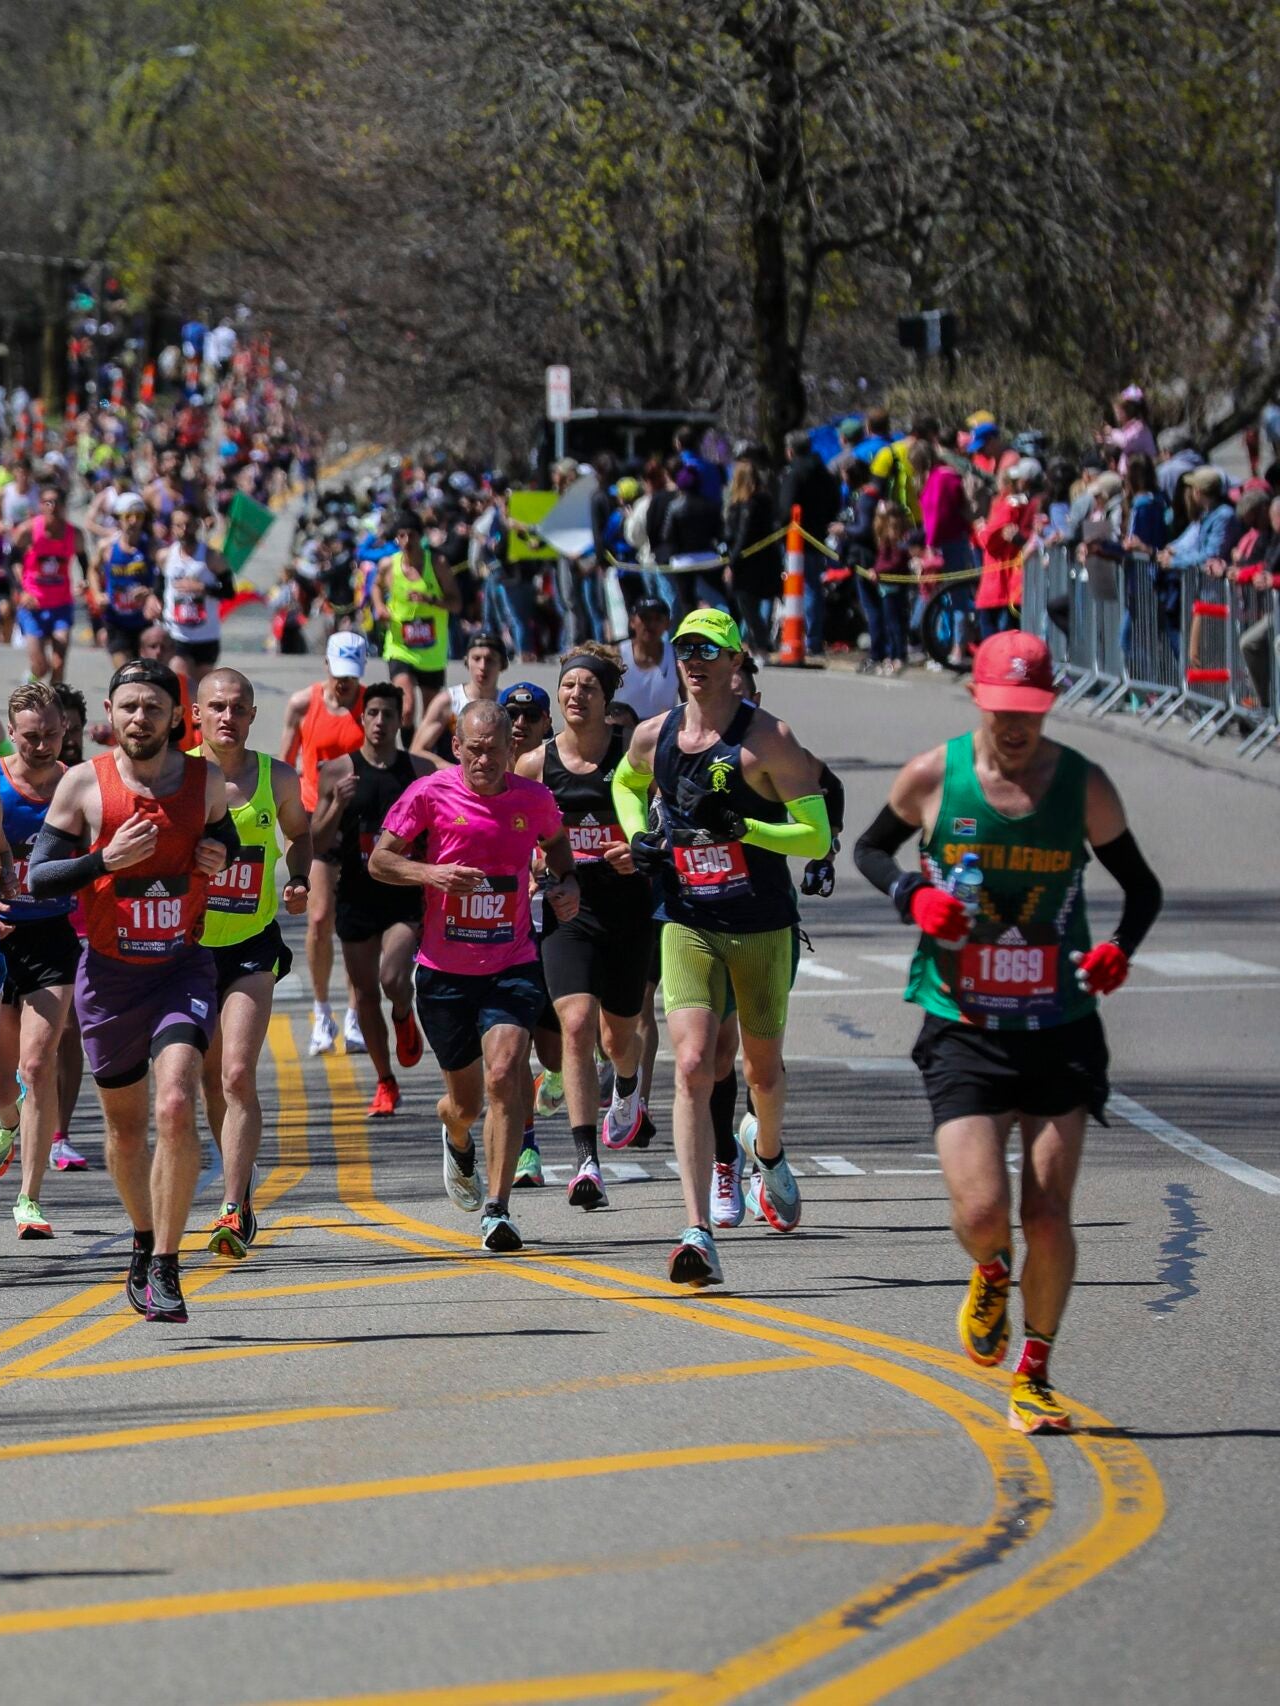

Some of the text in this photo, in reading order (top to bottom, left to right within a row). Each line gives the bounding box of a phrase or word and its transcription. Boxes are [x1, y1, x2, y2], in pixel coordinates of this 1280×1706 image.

[569, 827, 612, 850] 5621
[683, 846, 733, 875] 1505
[130, 898, 182, 929] 1168
[459, 895, 506, 919] 1062
[977, 945, 1044, 983] 1869
